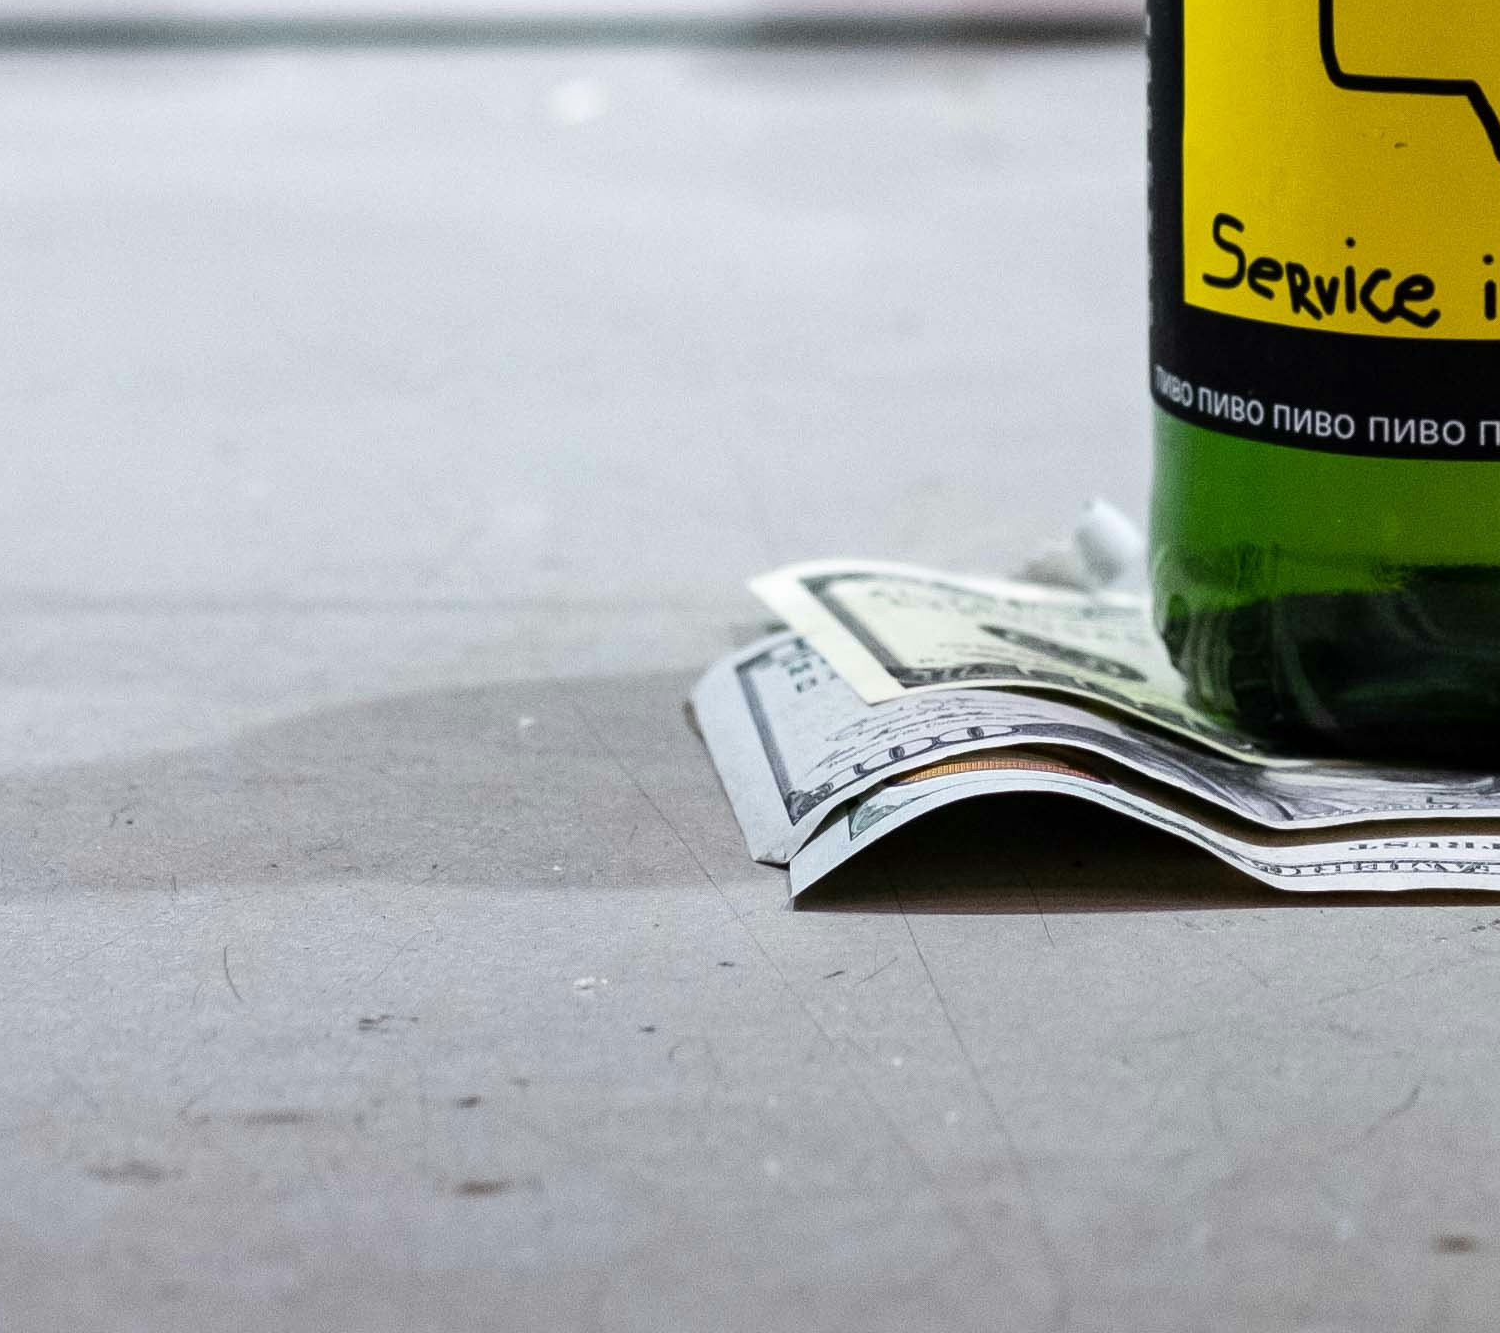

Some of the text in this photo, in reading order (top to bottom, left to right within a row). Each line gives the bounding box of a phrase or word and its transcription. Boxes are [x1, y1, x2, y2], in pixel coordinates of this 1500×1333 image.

[1197, 386, 1265, 426] ПИВО
[1273, 403, 1356, 440] ПИВО
[1368, 416, 1467, 446] ПИВО
